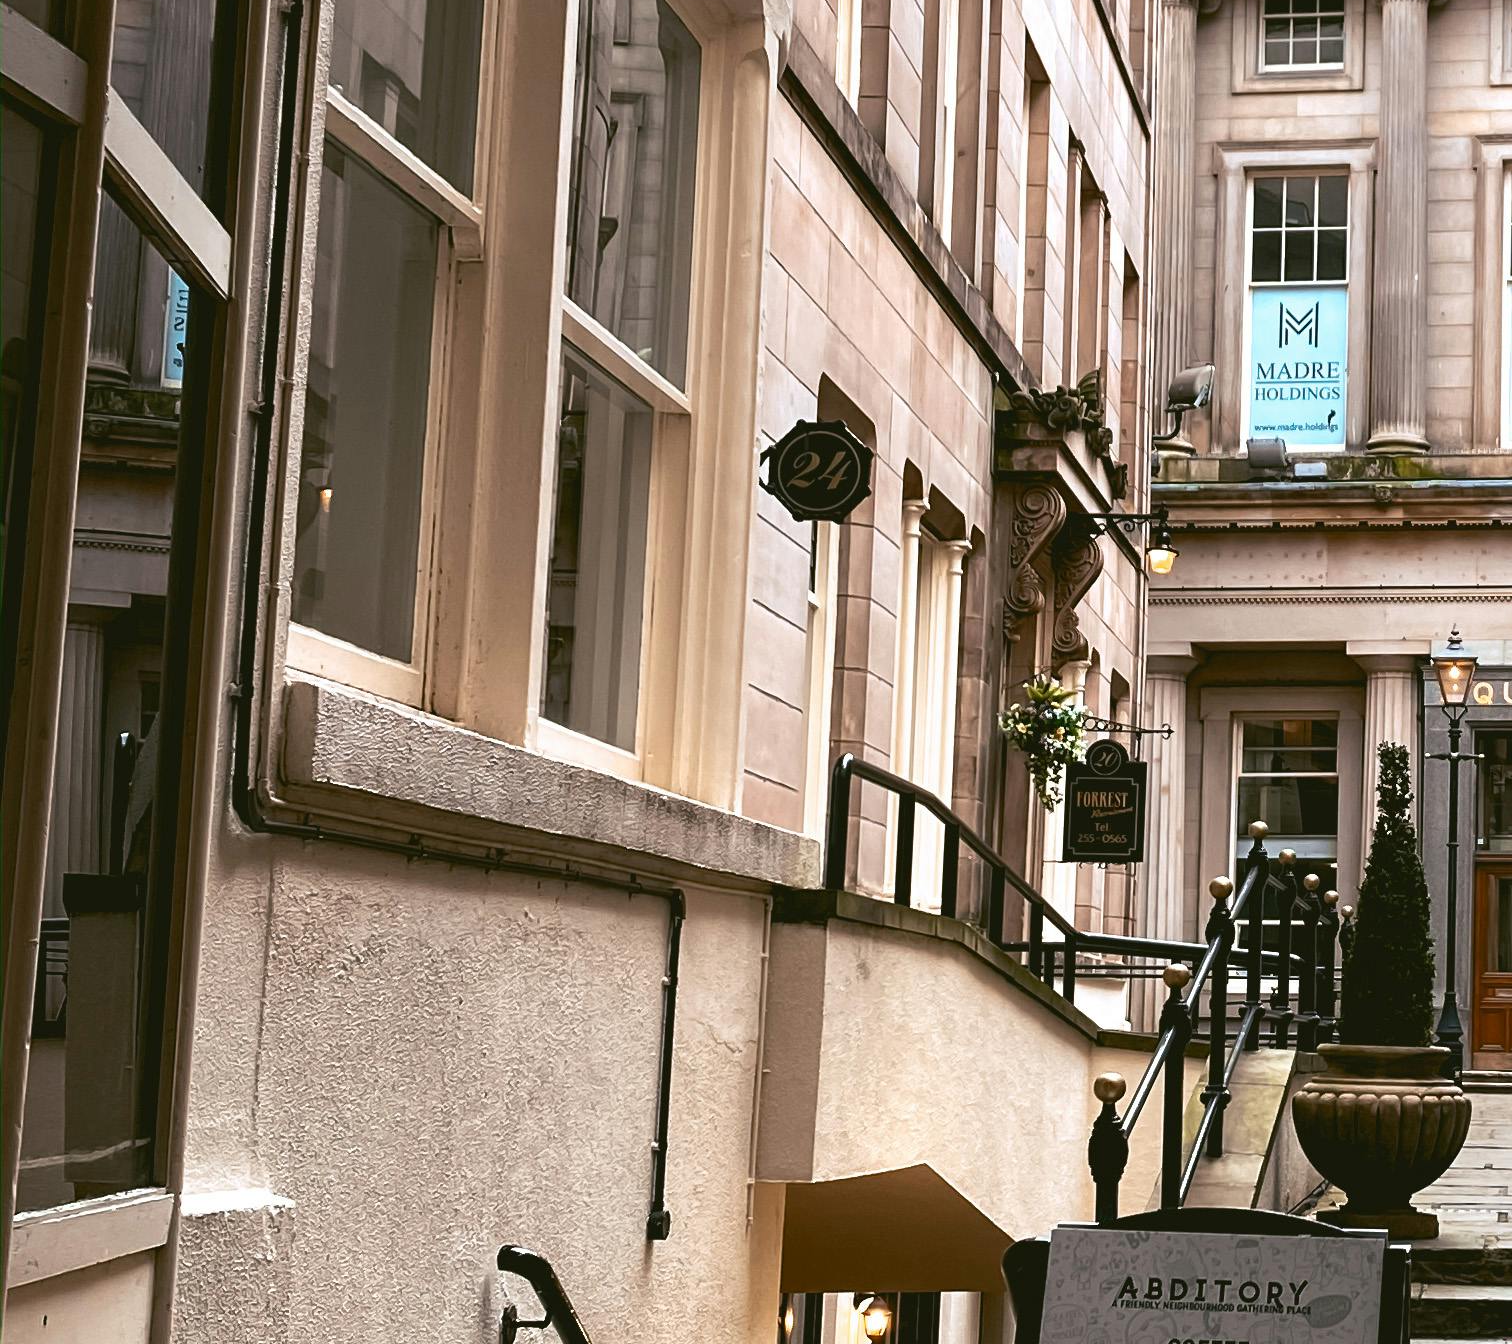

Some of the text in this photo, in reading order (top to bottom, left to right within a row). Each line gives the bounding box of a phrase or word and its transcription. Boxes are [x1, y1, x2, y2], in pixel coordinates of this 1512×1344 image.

[1257, 361, 1340, 380] MADRE
[1255, 387, 1340, 401] HOLDINGS
[1254, 422, 1339, 432] www.madre.holdings
[786, 451, 851, 490] 24
[1094, 751, 1118, 767] 20
[1077, 791, 1128, 807] FORREST
[1118, 1276, 1309, 1307] ABDITORY
[1112, 1299, 1118, 1307] A
[1120, 1300, 1160, 1310] FRIENDLY
[1163, 1301, 1234, 1312] NEIGHBOURHOOD
[1237, 1304, 1284, 1314] GATHERING
[1286, 1306, 1311, 1315] PLACE
